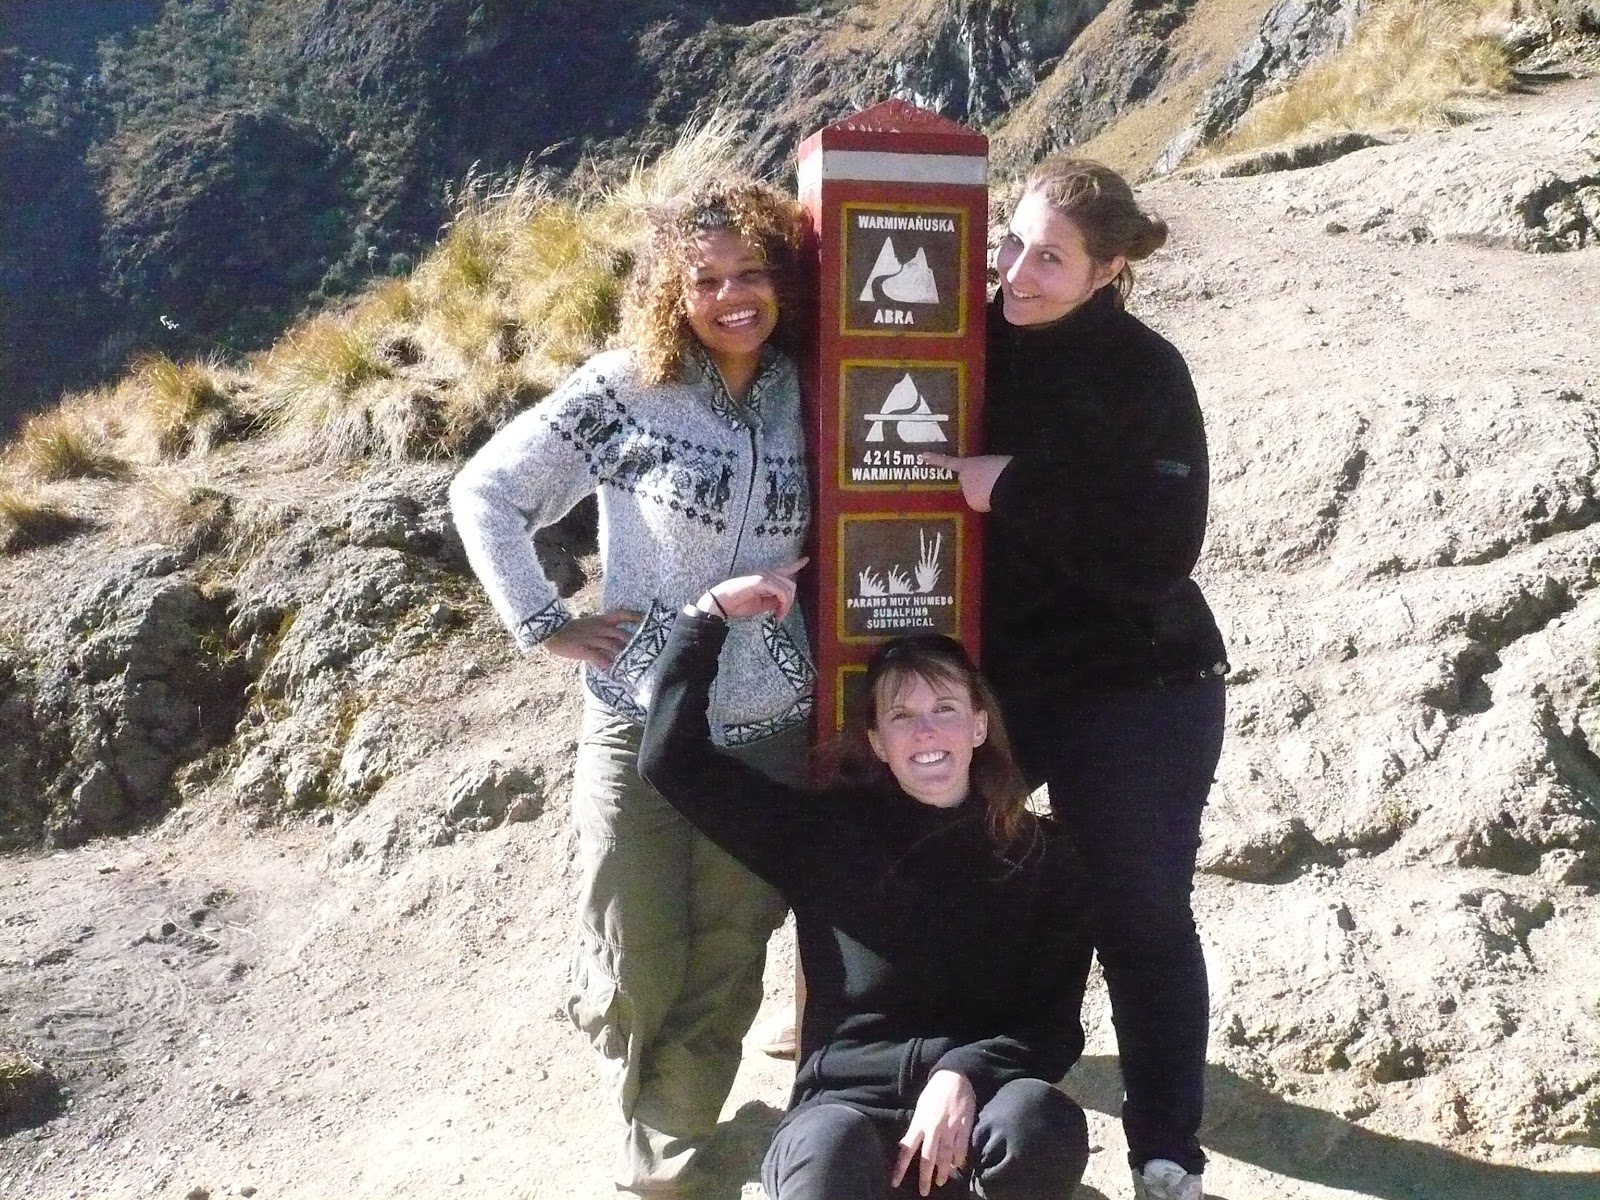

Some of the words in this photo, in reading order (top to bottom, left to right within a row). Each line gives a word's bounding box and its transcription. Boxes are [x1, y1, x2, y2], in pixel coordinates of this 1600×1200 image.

[858, 215, 955, 232] WARMIWAÑUSKA
[873, 309, 915, 325] ABRA
[863, 450, 930, 466] 4215ms
[852, 466, 953, 481] WARMIWAÑUSKA
[889, 597, 911, 606] MUY
[873, 607, 928, 618] SUBALPINO
[866, 618, 935, 629] SUBTROPICAL
